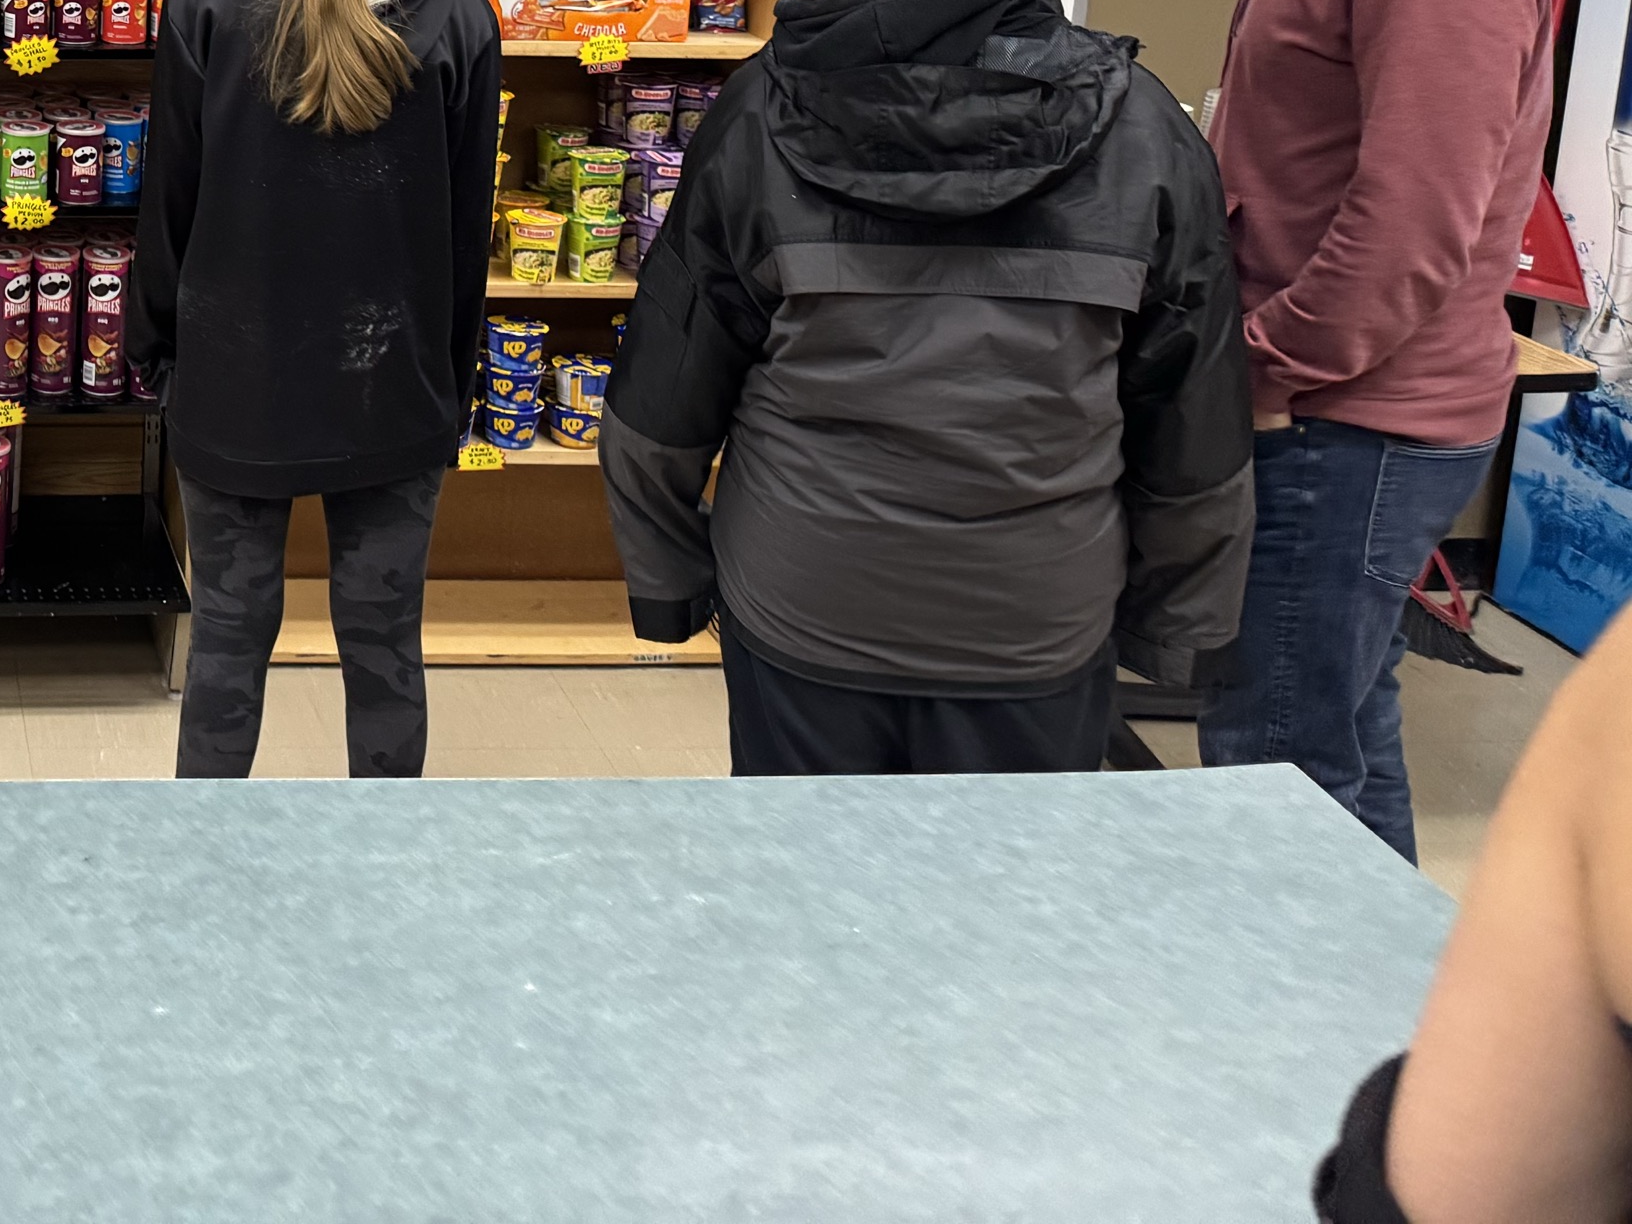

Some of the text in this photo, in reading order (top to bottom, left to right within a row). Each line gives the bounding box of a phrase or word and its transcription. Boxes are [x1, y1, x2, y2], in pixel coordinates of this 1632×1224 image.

[574, 22, 627, 37] CHEDDAR
[11, 201, 47, 212] PRINGLES
[14, 216, 45, 226] $2.00
[37, 295, 71, 313] PRINGLES
[503, 340, 527, 358] KD
[493, 378, 514, 396] KD
